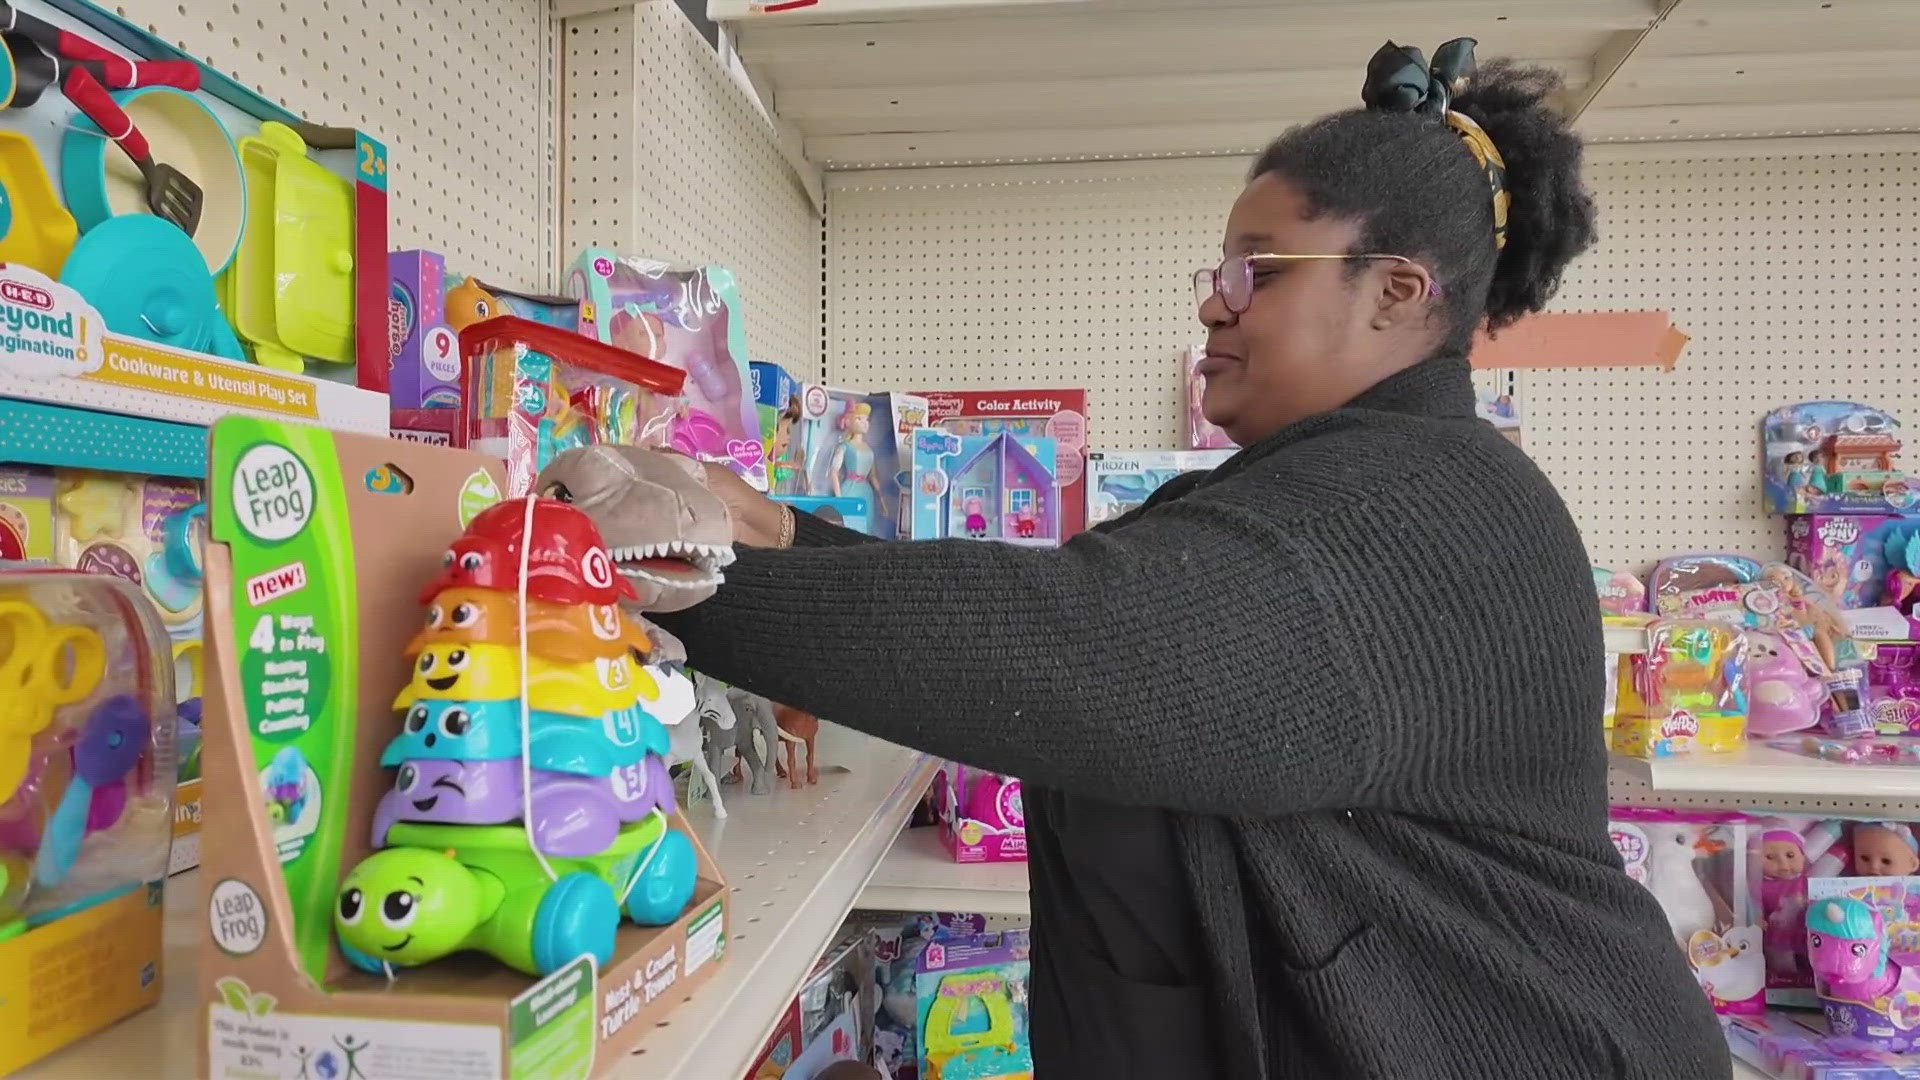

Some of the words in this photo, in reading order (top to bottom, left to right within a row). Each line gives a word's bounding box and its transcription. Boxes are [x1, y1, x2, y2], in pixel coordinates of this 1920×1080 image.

[361, 142, 385, 176] 2+
[435, 332, 450, 359] 9
[109, 352, 188, 384] Cookware
[193, 371, 204, 386] &
[208, 372, 256, 396] Utensil
[259, 383, 285, 405] Play
[287, 388, 308, 406] Set
[430, 361, 456, 374] PIECES
[977, 400, 1010, 411] Color
[1012, 398, 1061, 412] Activity
[242, 459, 298, 496] Leap
[1095, 460, 1140, 471] FROZEN
[250, 490, 305, 527] Frog
[252, 567, 302, 599] new!
[250, 614, 275, 653] 4
[602, 607, 615, 633] 2
[279, 637, 295, 651] to
[297, 634, 325, 654] Play
[618, 708, 632, 736] 4
[627, 765, 638, 791] 5
[215, 892, 254, 919] Leap
[220, 914, 259, 942] Frog
[600, 995, 640, 1040] Turtle
[644, 964, 678, 1003] Tower
